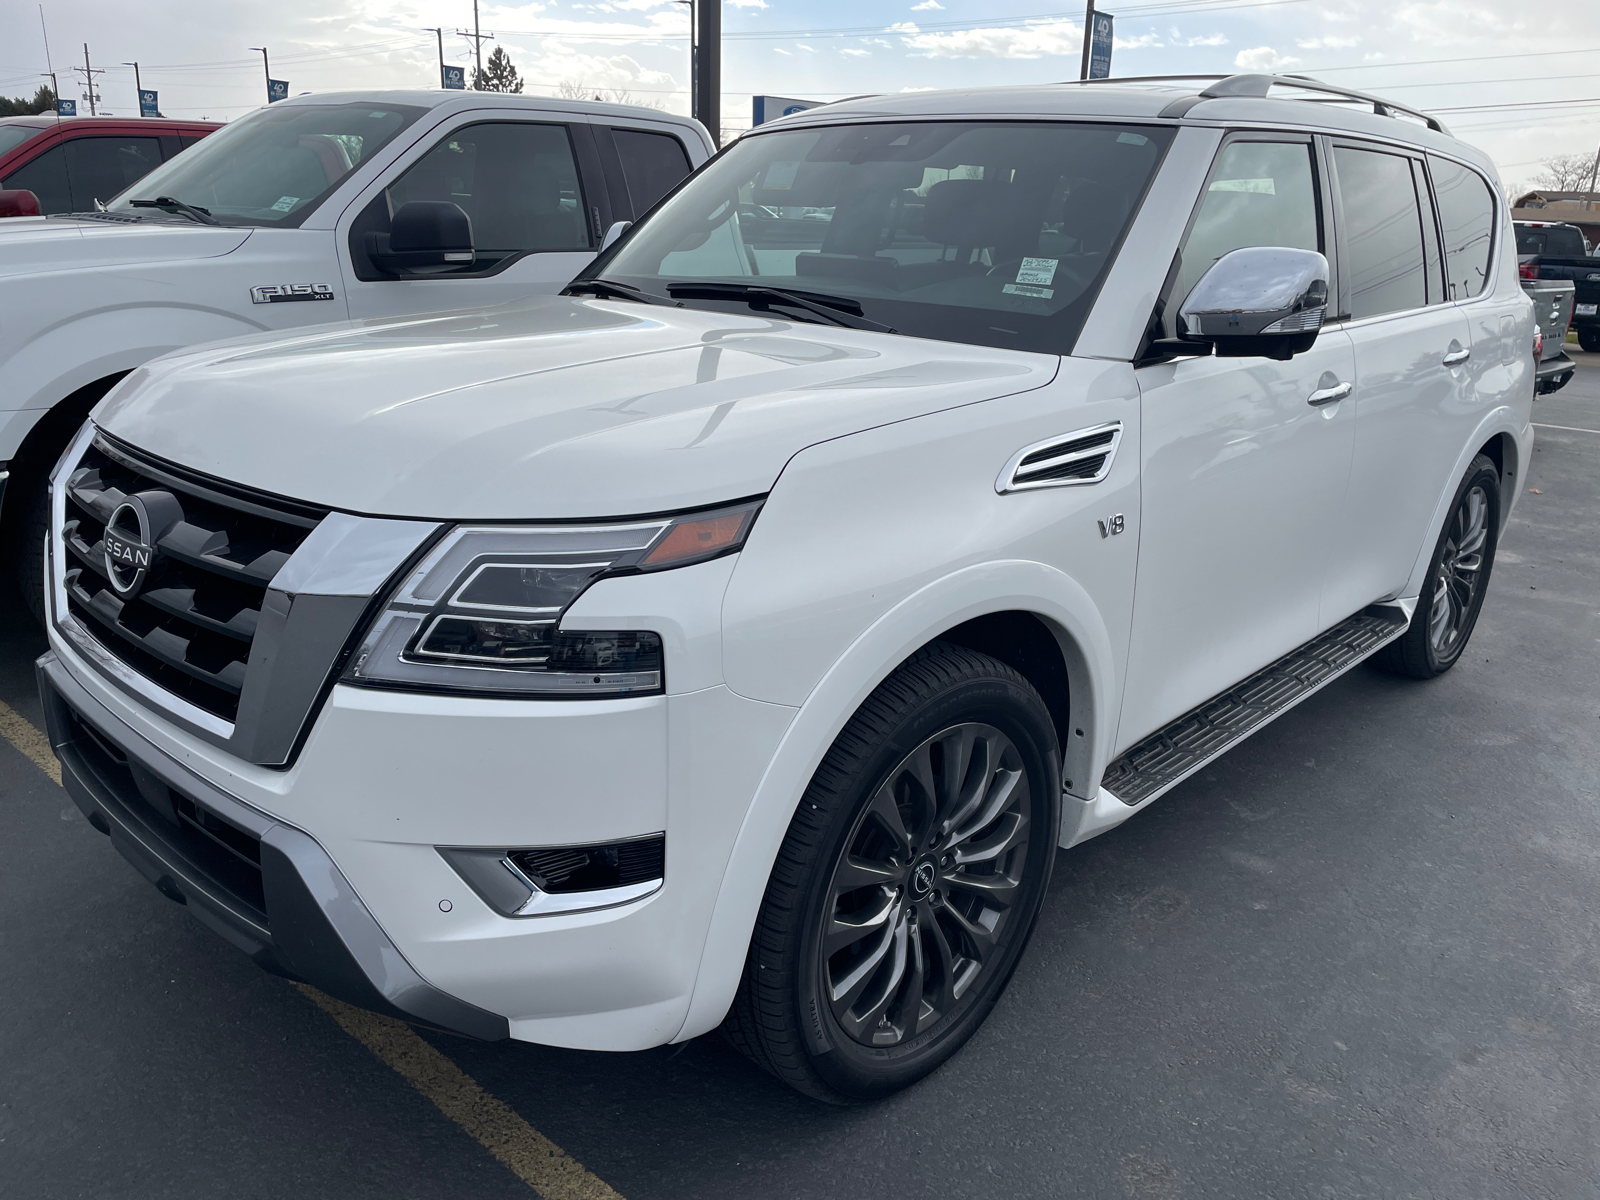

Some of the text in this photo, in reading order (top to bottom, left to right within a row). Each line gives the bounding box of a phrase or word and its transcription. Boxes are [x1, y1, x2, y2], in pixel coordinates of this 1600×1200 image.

[1097, 19, 1109, 34] 40
[449, 69, 460, 79] 40
[274, 83, 284, 91] 40
[143, 92, 154, 101] 40
[62, 101, 73, 109] 40
[1097, 513, 1124, 539] V8
[106, 538, 149, 566] SSAN
[809, 998, 823, 1040] AS ULTRA
